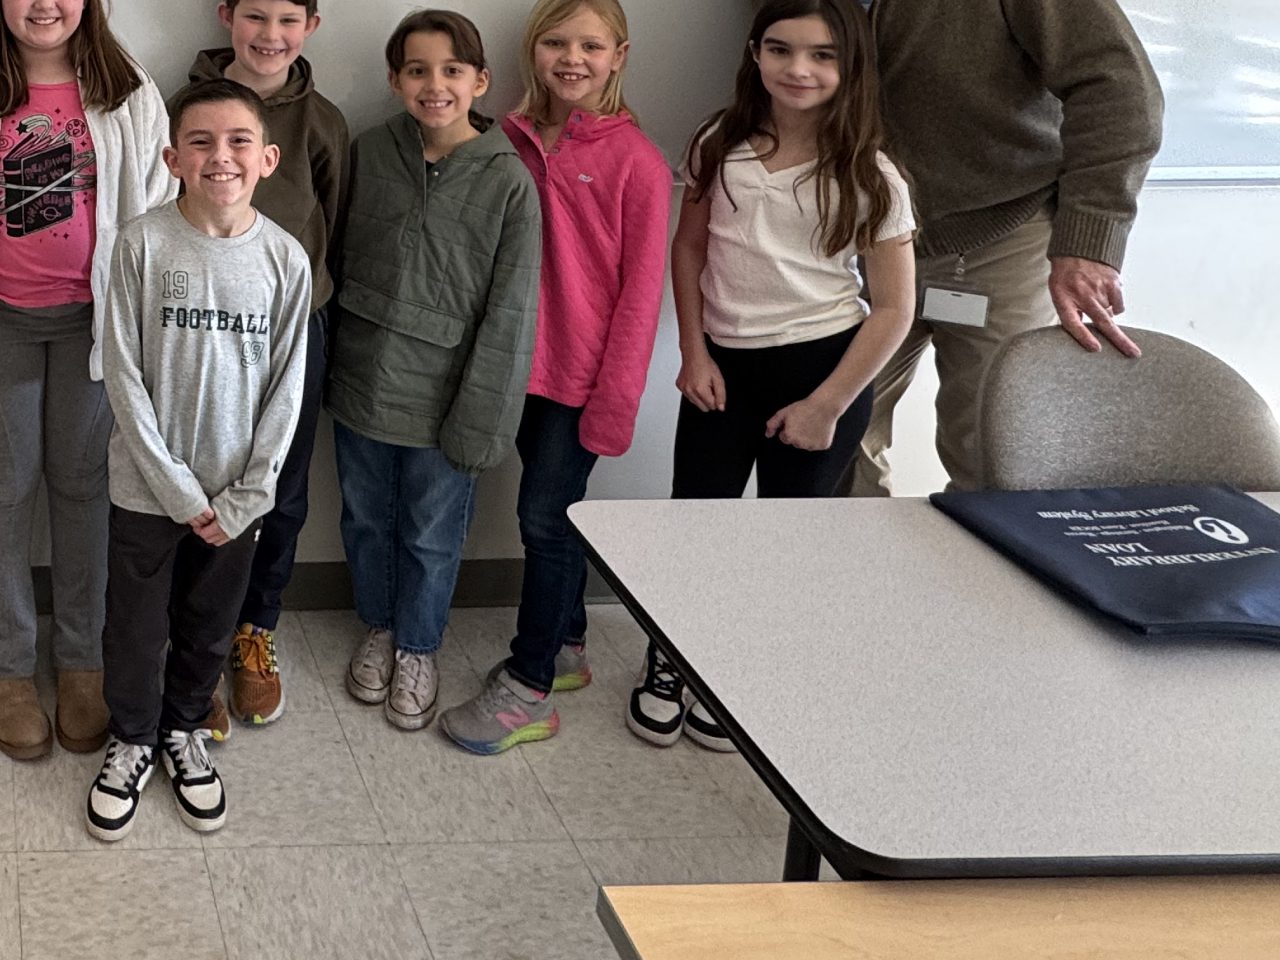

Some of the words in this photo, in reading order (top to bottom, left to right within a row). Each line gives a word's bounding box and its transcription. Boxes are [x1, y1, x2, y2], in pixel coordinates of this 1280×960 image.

[38, 174, 48, 184] IS
[161, 270, 188, 299] 19
[161, 305, 268, 334] FOOTBALL
[240, 341, 265, 368] 98
[1036, 509, 1094, 521] System
[1091, 510, 1152, 518] Library
[1146, 504, 1200, 516] School
[1083, 543, 1153, 553] LOAN
[1105, 547, 1279, 566] INTERLIBRARY
